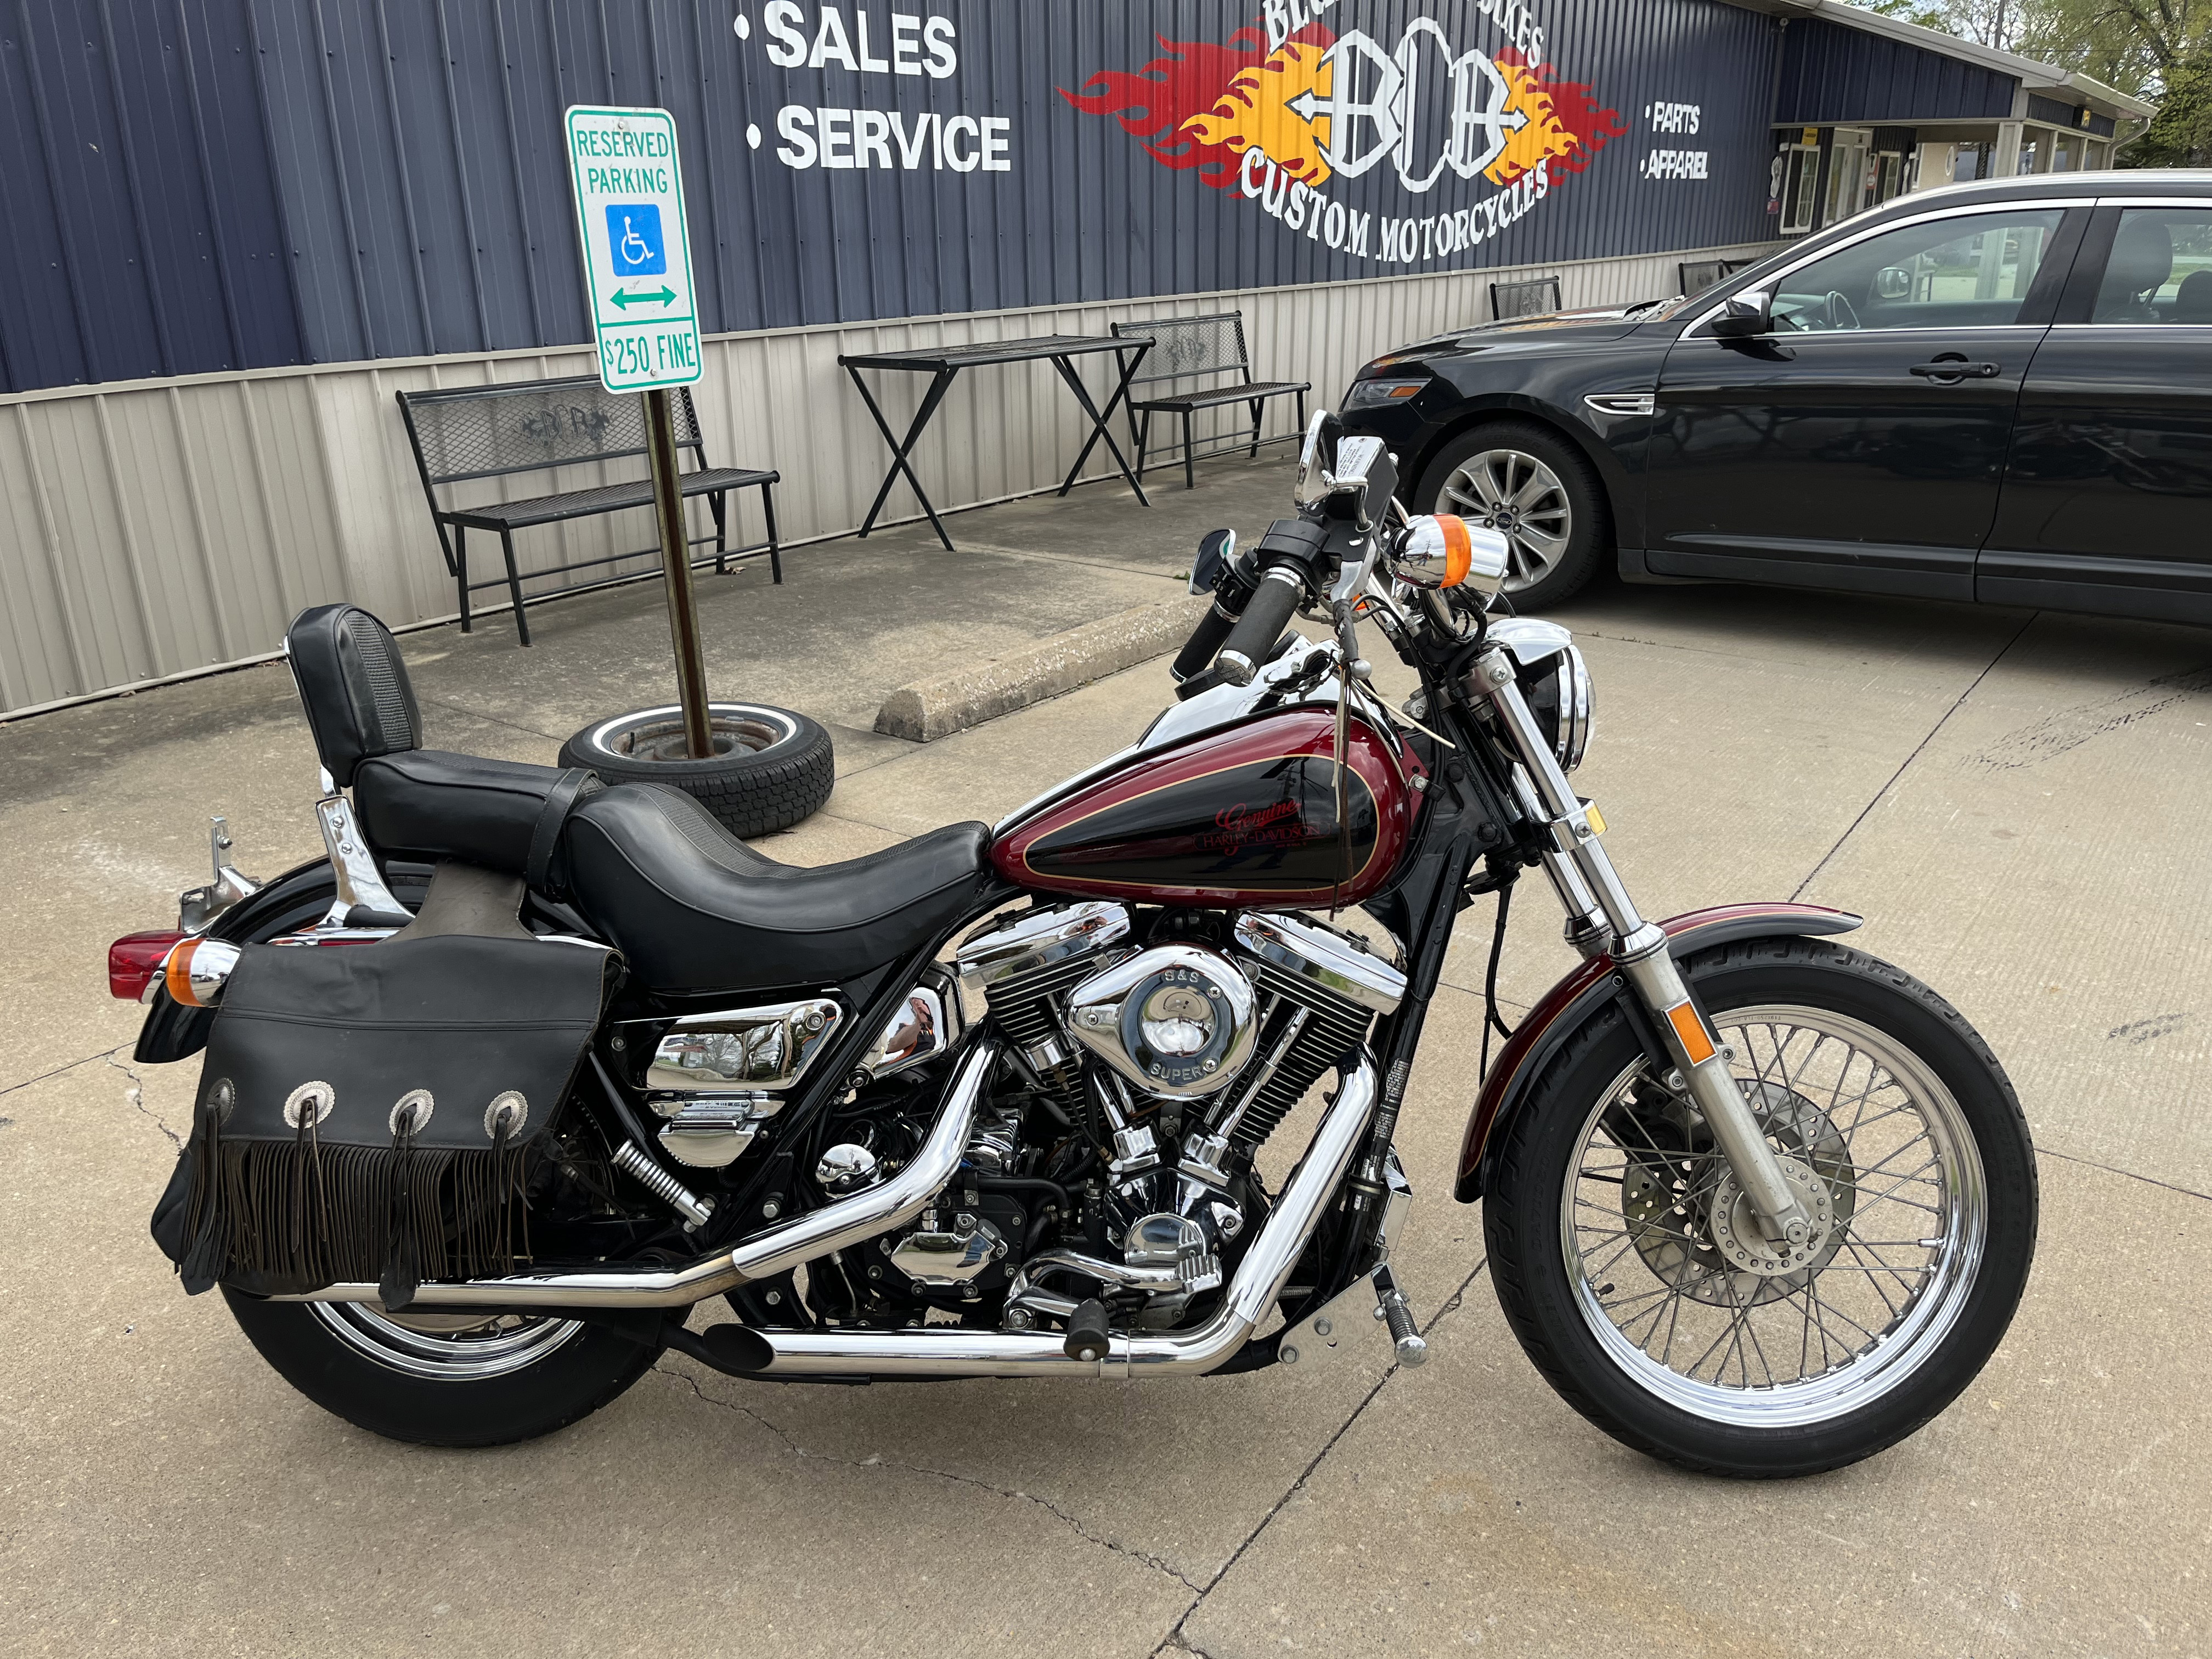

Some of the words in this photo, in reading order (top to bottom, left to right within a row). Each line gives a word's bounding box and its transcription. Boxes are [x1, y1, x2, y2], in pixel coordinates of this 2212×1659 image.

[764, 0, 957, 78] SALES
[1652, 101, 1701, 134] PARTS
[577, 130, 669, 157] RESERVED
[776, 105, 1011, 172] SERVICE
[1644, 149, 1708, 179] APPAREL
[588, 168, 668, 194] PARKING
[1242, 147, 1370, 258] CUSTOM
[1375, 157, 1548, 263] MOTORCYCLES
[605, 336, 650, 374] $250
[658, 332, 696, 370] FINE
[1204, 824, 1321, 848] HARLEY-DAVIDSON
[1215, 798, 1301, 856] Genuine
[1164, 969, 1200, 983] S&S
[1150, 1063, 1206, 1080] SUPER
